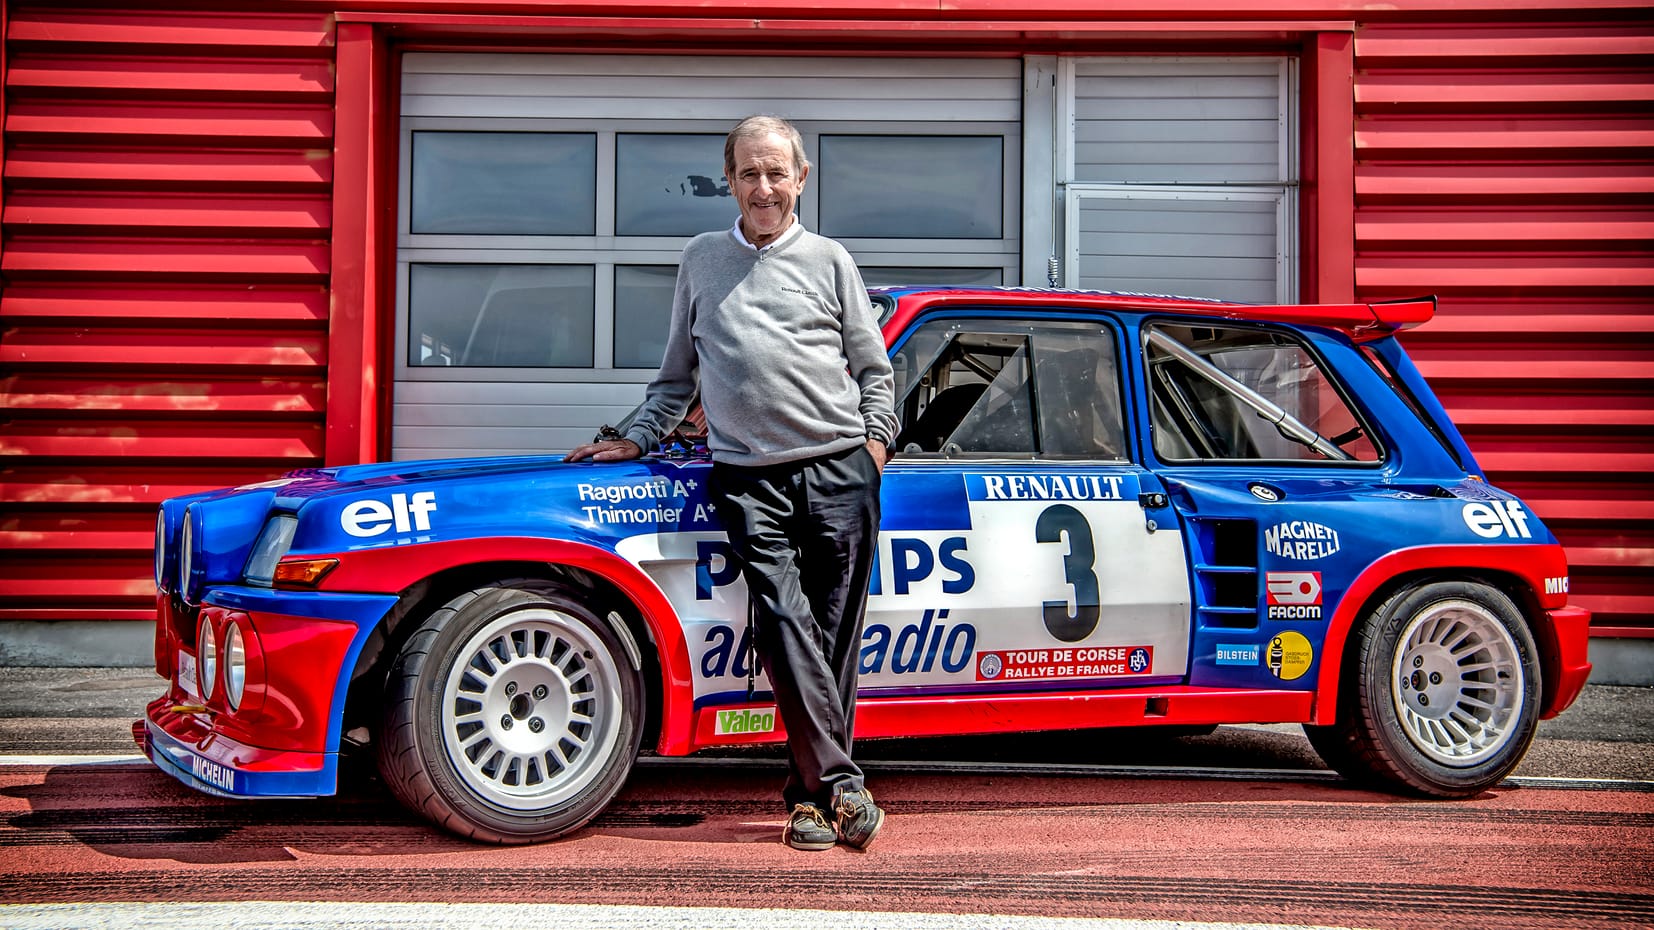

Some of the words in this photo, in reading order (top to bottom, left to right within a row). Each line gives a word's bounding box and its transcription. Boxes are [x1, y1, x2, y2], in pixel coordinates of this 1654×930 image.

[578, 481, 667, 503] Ragnotti
[982, 475, 1123, 500] RENAULT
[340, 491, 437, 537] elf
[581, 504, 683, 525] Thimonier
[1462, 500, 1532, 538] elf
[1264, 520, 1340, 549] MAGNETI
[1264, 534, 1340, 560] MARELLI
[1036, 504, 1100, 642] 3
[1268, 606, 1321, 618] FACOM
[1006, 651, 1049, 665] TOUR
[1053, 650, 1073, 663] DE
[1076, 649, 1126, 662] CORSE
[1217, 650, 1258, 660] BILSTEIN
[1005, 666, 1055, 678] RALLYE
[1057, 665, 1074, 675] DE
[1077, 664, 1125, 675] FRANCE
[718, 710, 774, 733] Valeo
[192, 755, 235, 791] MICHELIN
